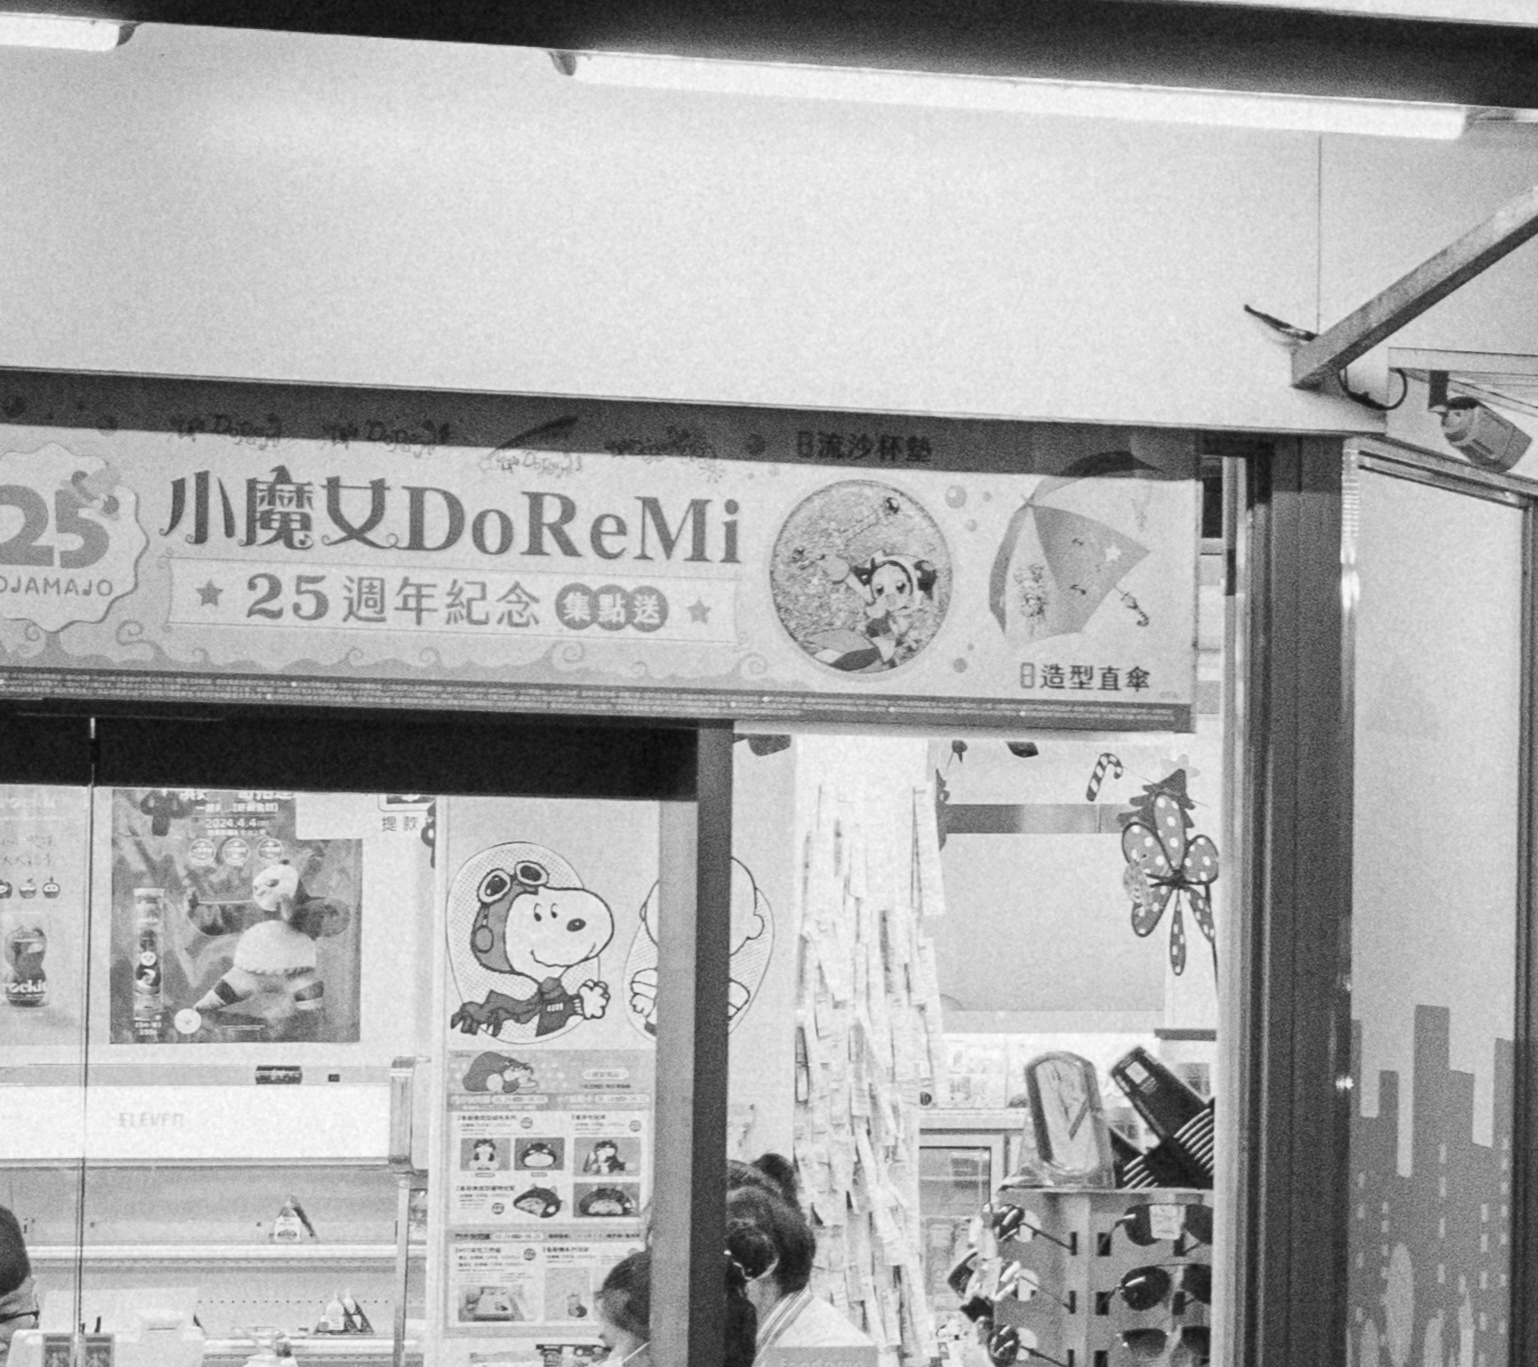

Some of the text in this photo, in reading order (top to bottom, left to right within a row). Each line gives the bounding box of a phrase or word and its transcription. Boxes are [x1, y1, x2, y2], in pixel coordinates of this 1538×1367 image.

[0, 485, 110, 569] 25
[561, 588, 662, 623] 集點送
